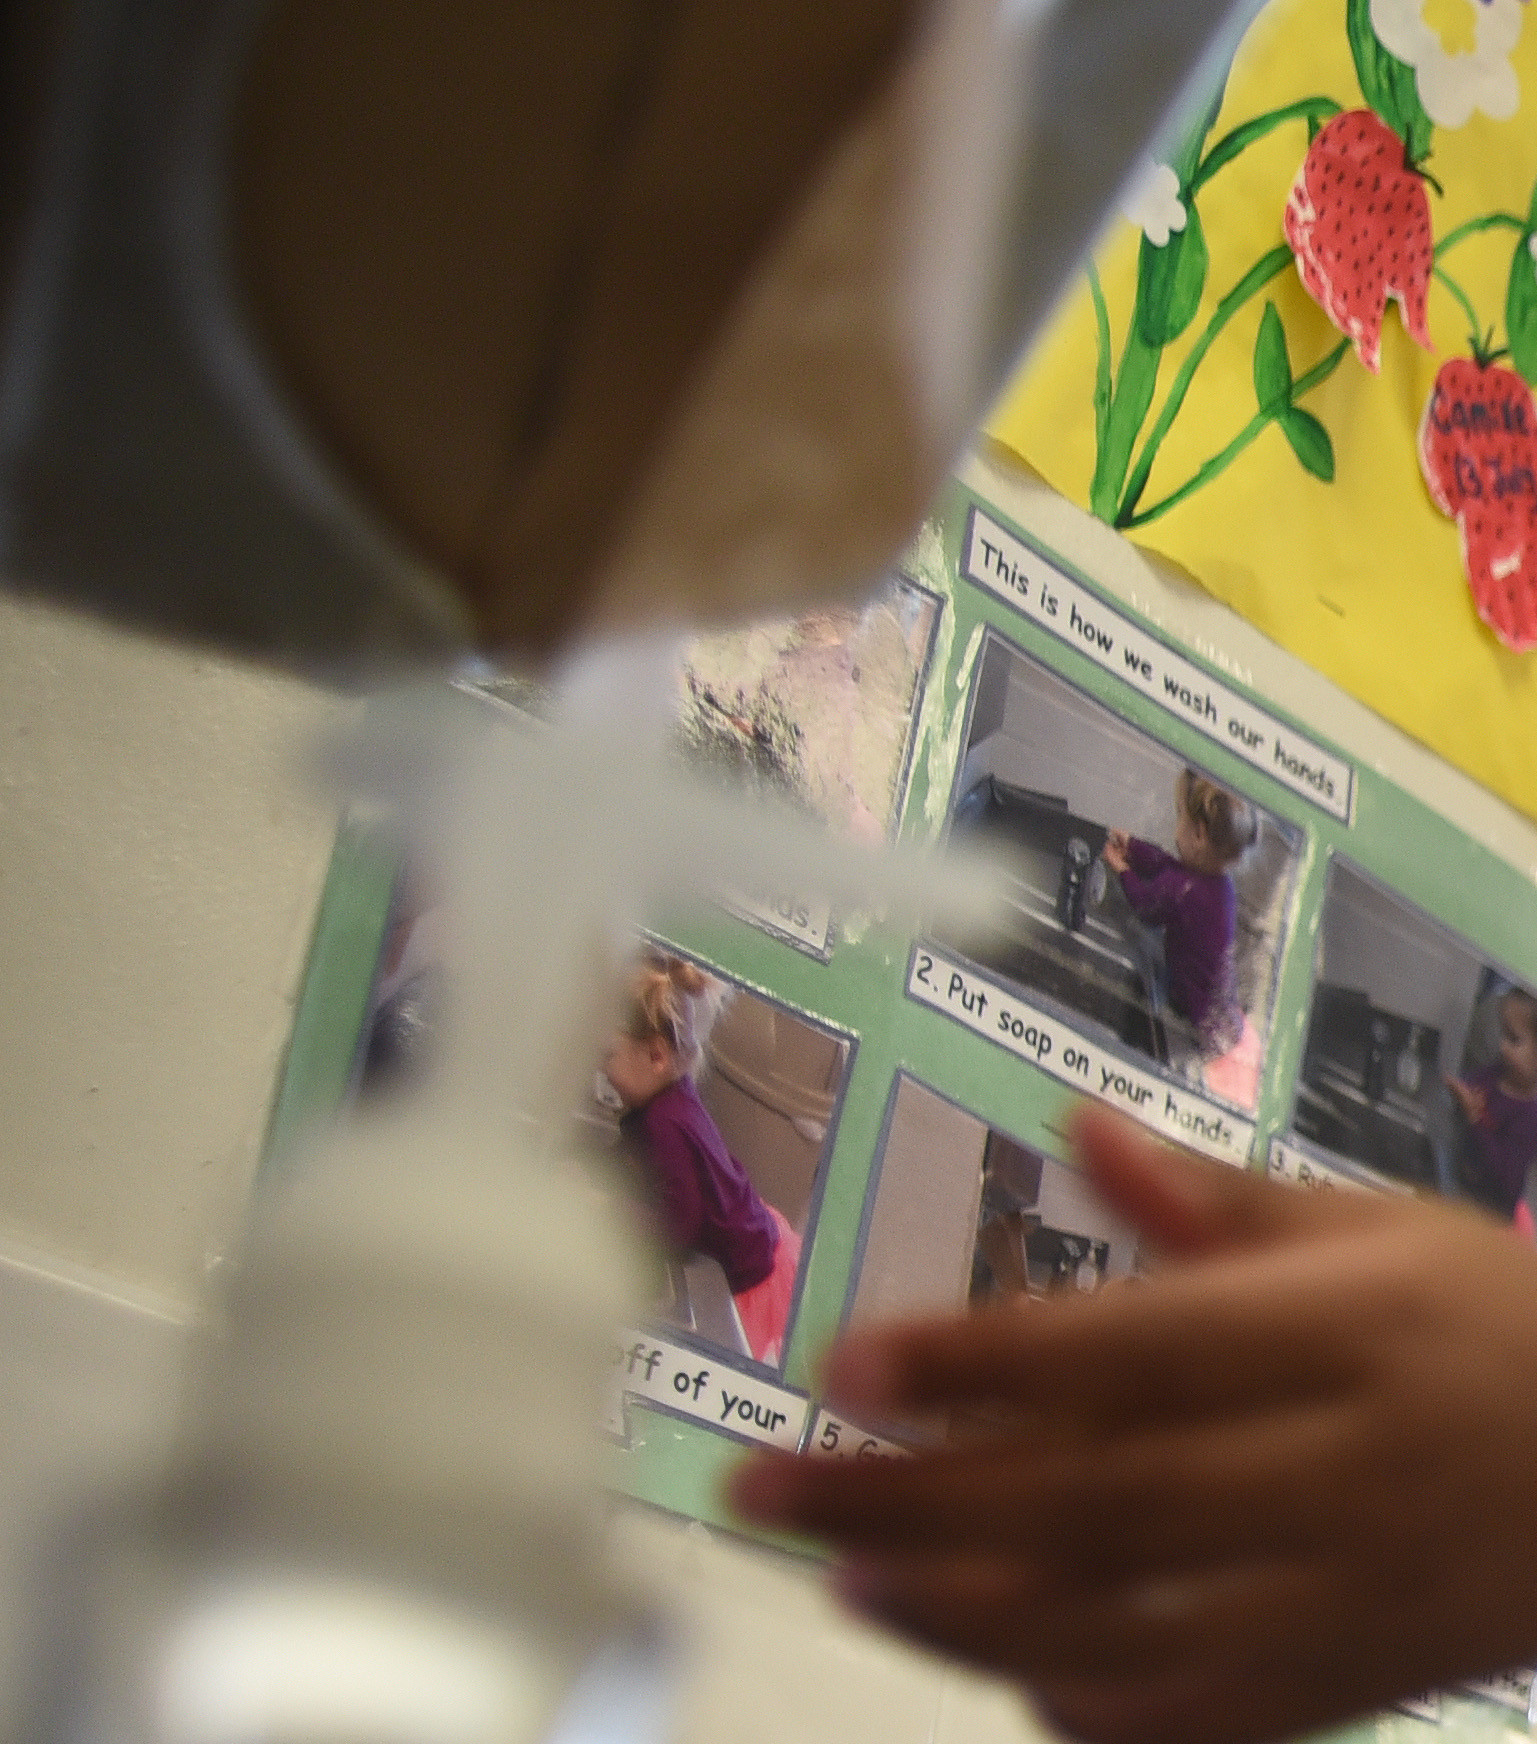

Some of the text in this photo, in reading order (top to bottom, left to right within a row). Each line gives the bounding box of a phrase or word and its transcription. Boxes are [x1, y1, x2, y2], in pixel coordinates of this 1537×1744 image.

[980, 537, 1029, 596] This
[1040, 583, 1059, 617] is
[1069, 602, 1114, 655] how
[1123, 648, 1153, 682] we
[1163, 674, 1218, 724] wash
[1227, 717, 1264, 749] our
[916, 955, 939, 992] 2.
[948, 972, 988, 1018] Put
[997, 1010, 1052, 1061] soap
[1062, 1048, 1089, 1077] on
[1100, 1066, 1153, 1105] your
[673, 1370, 711, 1401] of
[720, 1389, 787, 1432] your
